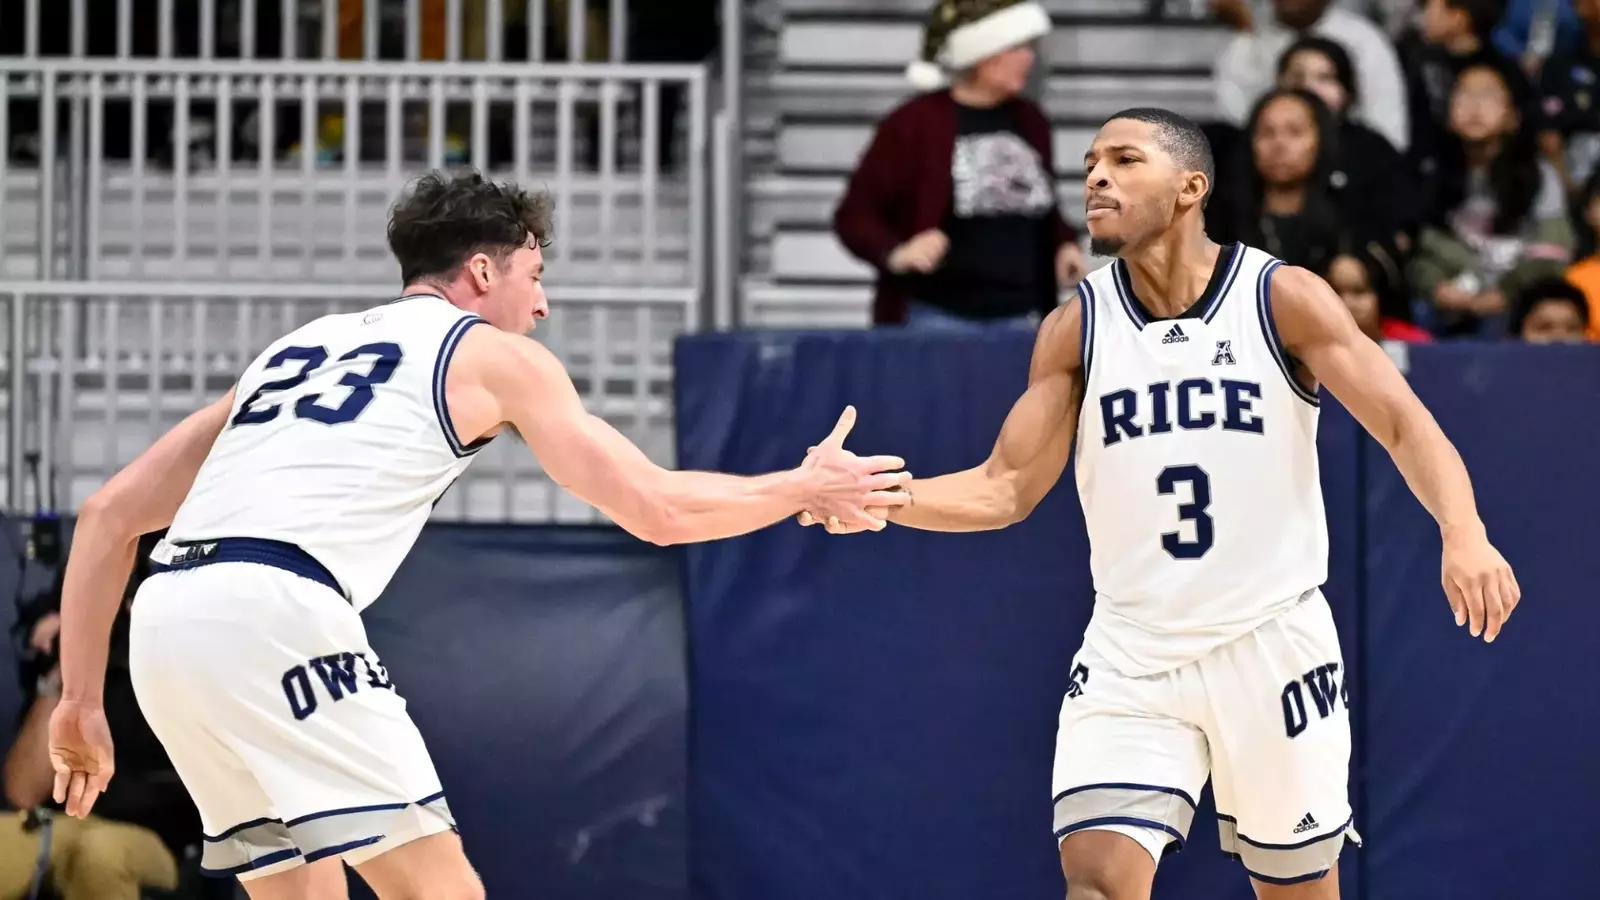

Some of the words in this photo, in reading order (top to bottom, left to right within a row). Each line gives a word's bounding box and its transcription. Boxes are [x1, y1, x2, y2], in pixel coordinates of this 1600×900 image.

[1161, 335, 1190, 345] adidas
[228, 341, 405, 428] 23
[1099, 376, 1265, 448] RICE
[1155, 462, 1216, 561] 3
